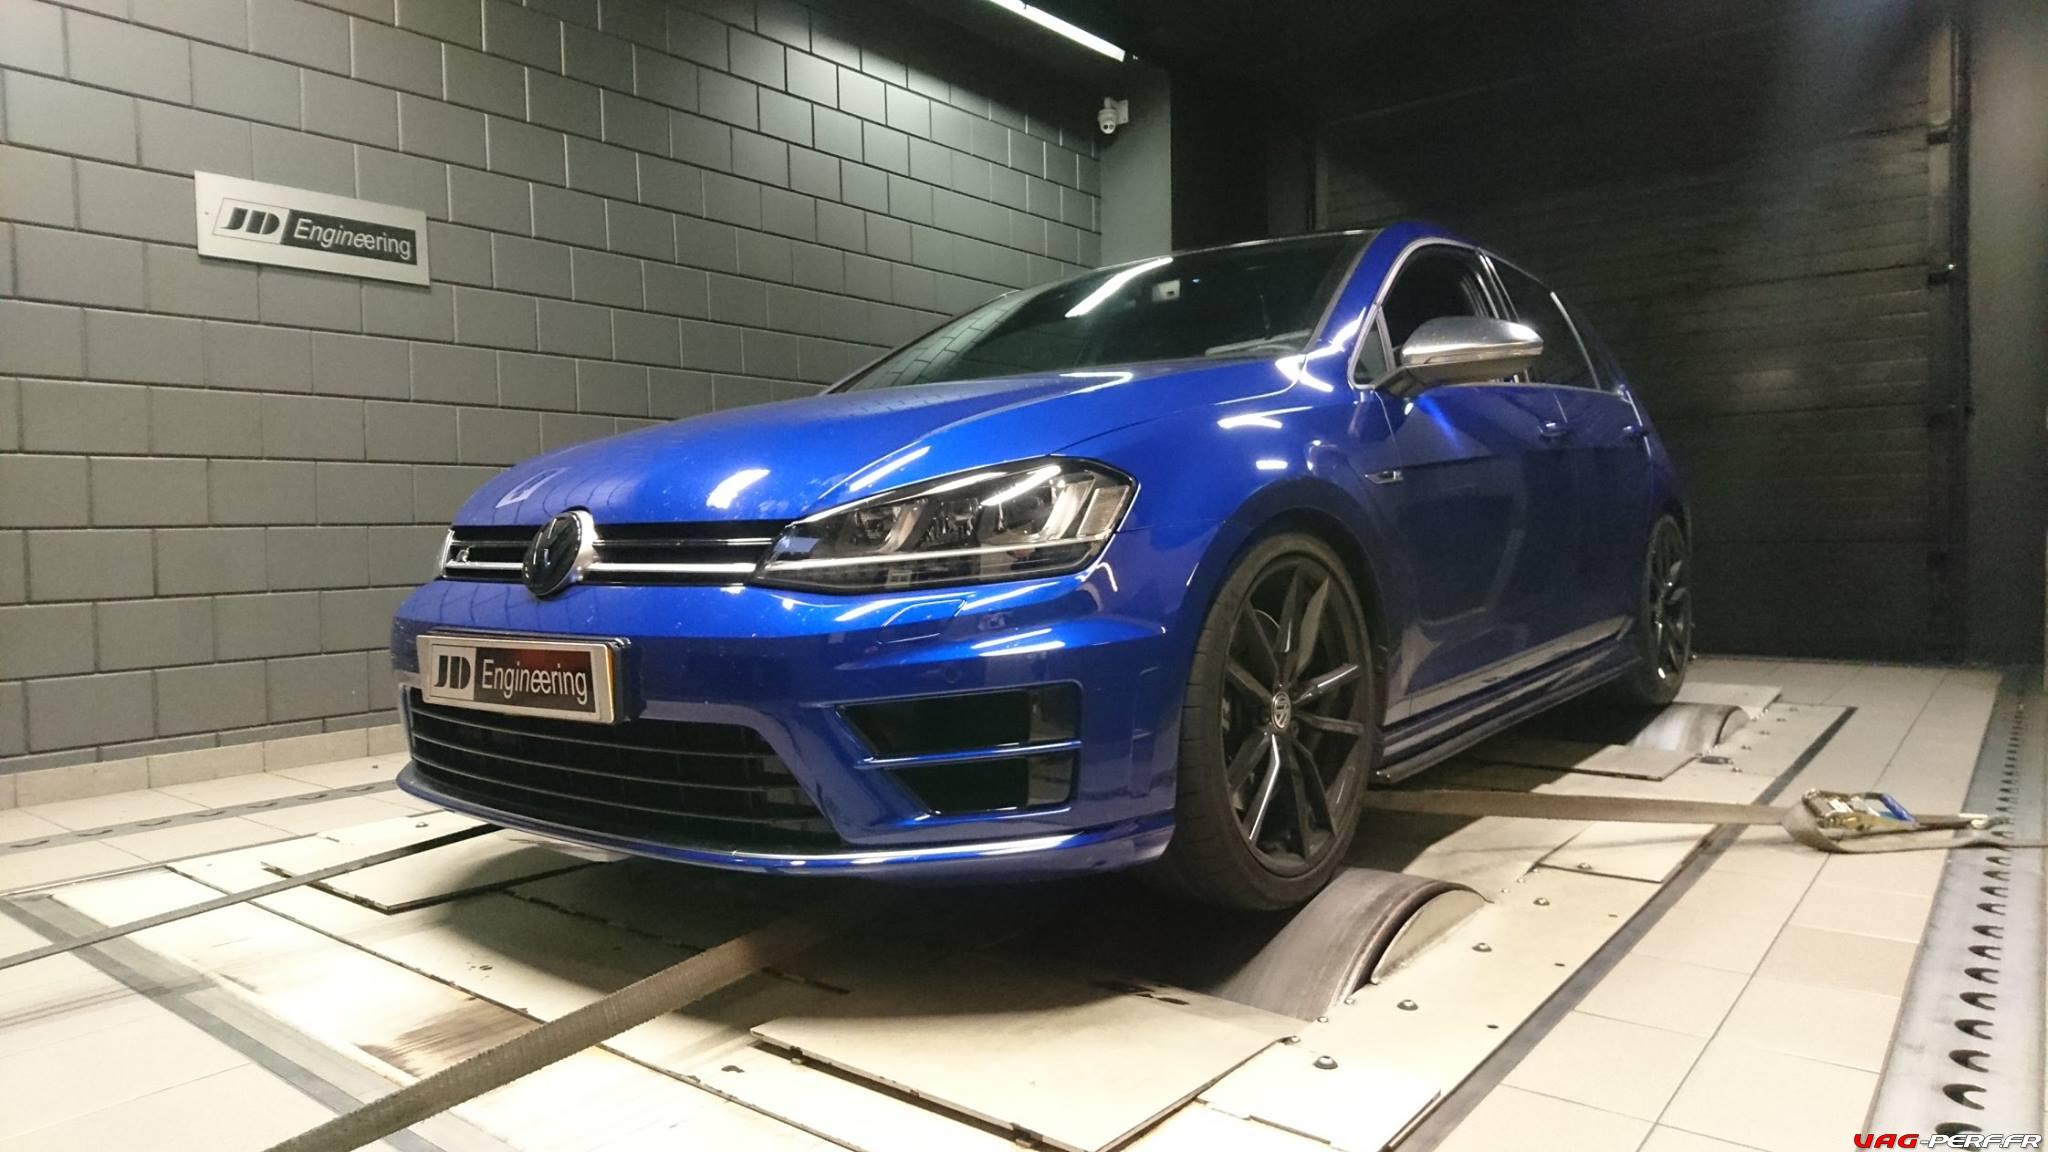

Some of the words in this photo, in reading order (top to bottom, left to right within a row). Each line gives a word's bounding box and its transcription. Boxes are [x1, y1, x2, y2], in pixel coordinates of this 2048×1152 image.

[220, 207, 280, 235] JD
[294, 218, 411, 260] Engineering
[434, 655, 471, 689] JD
[482, 659, 587, 705] Engineering
